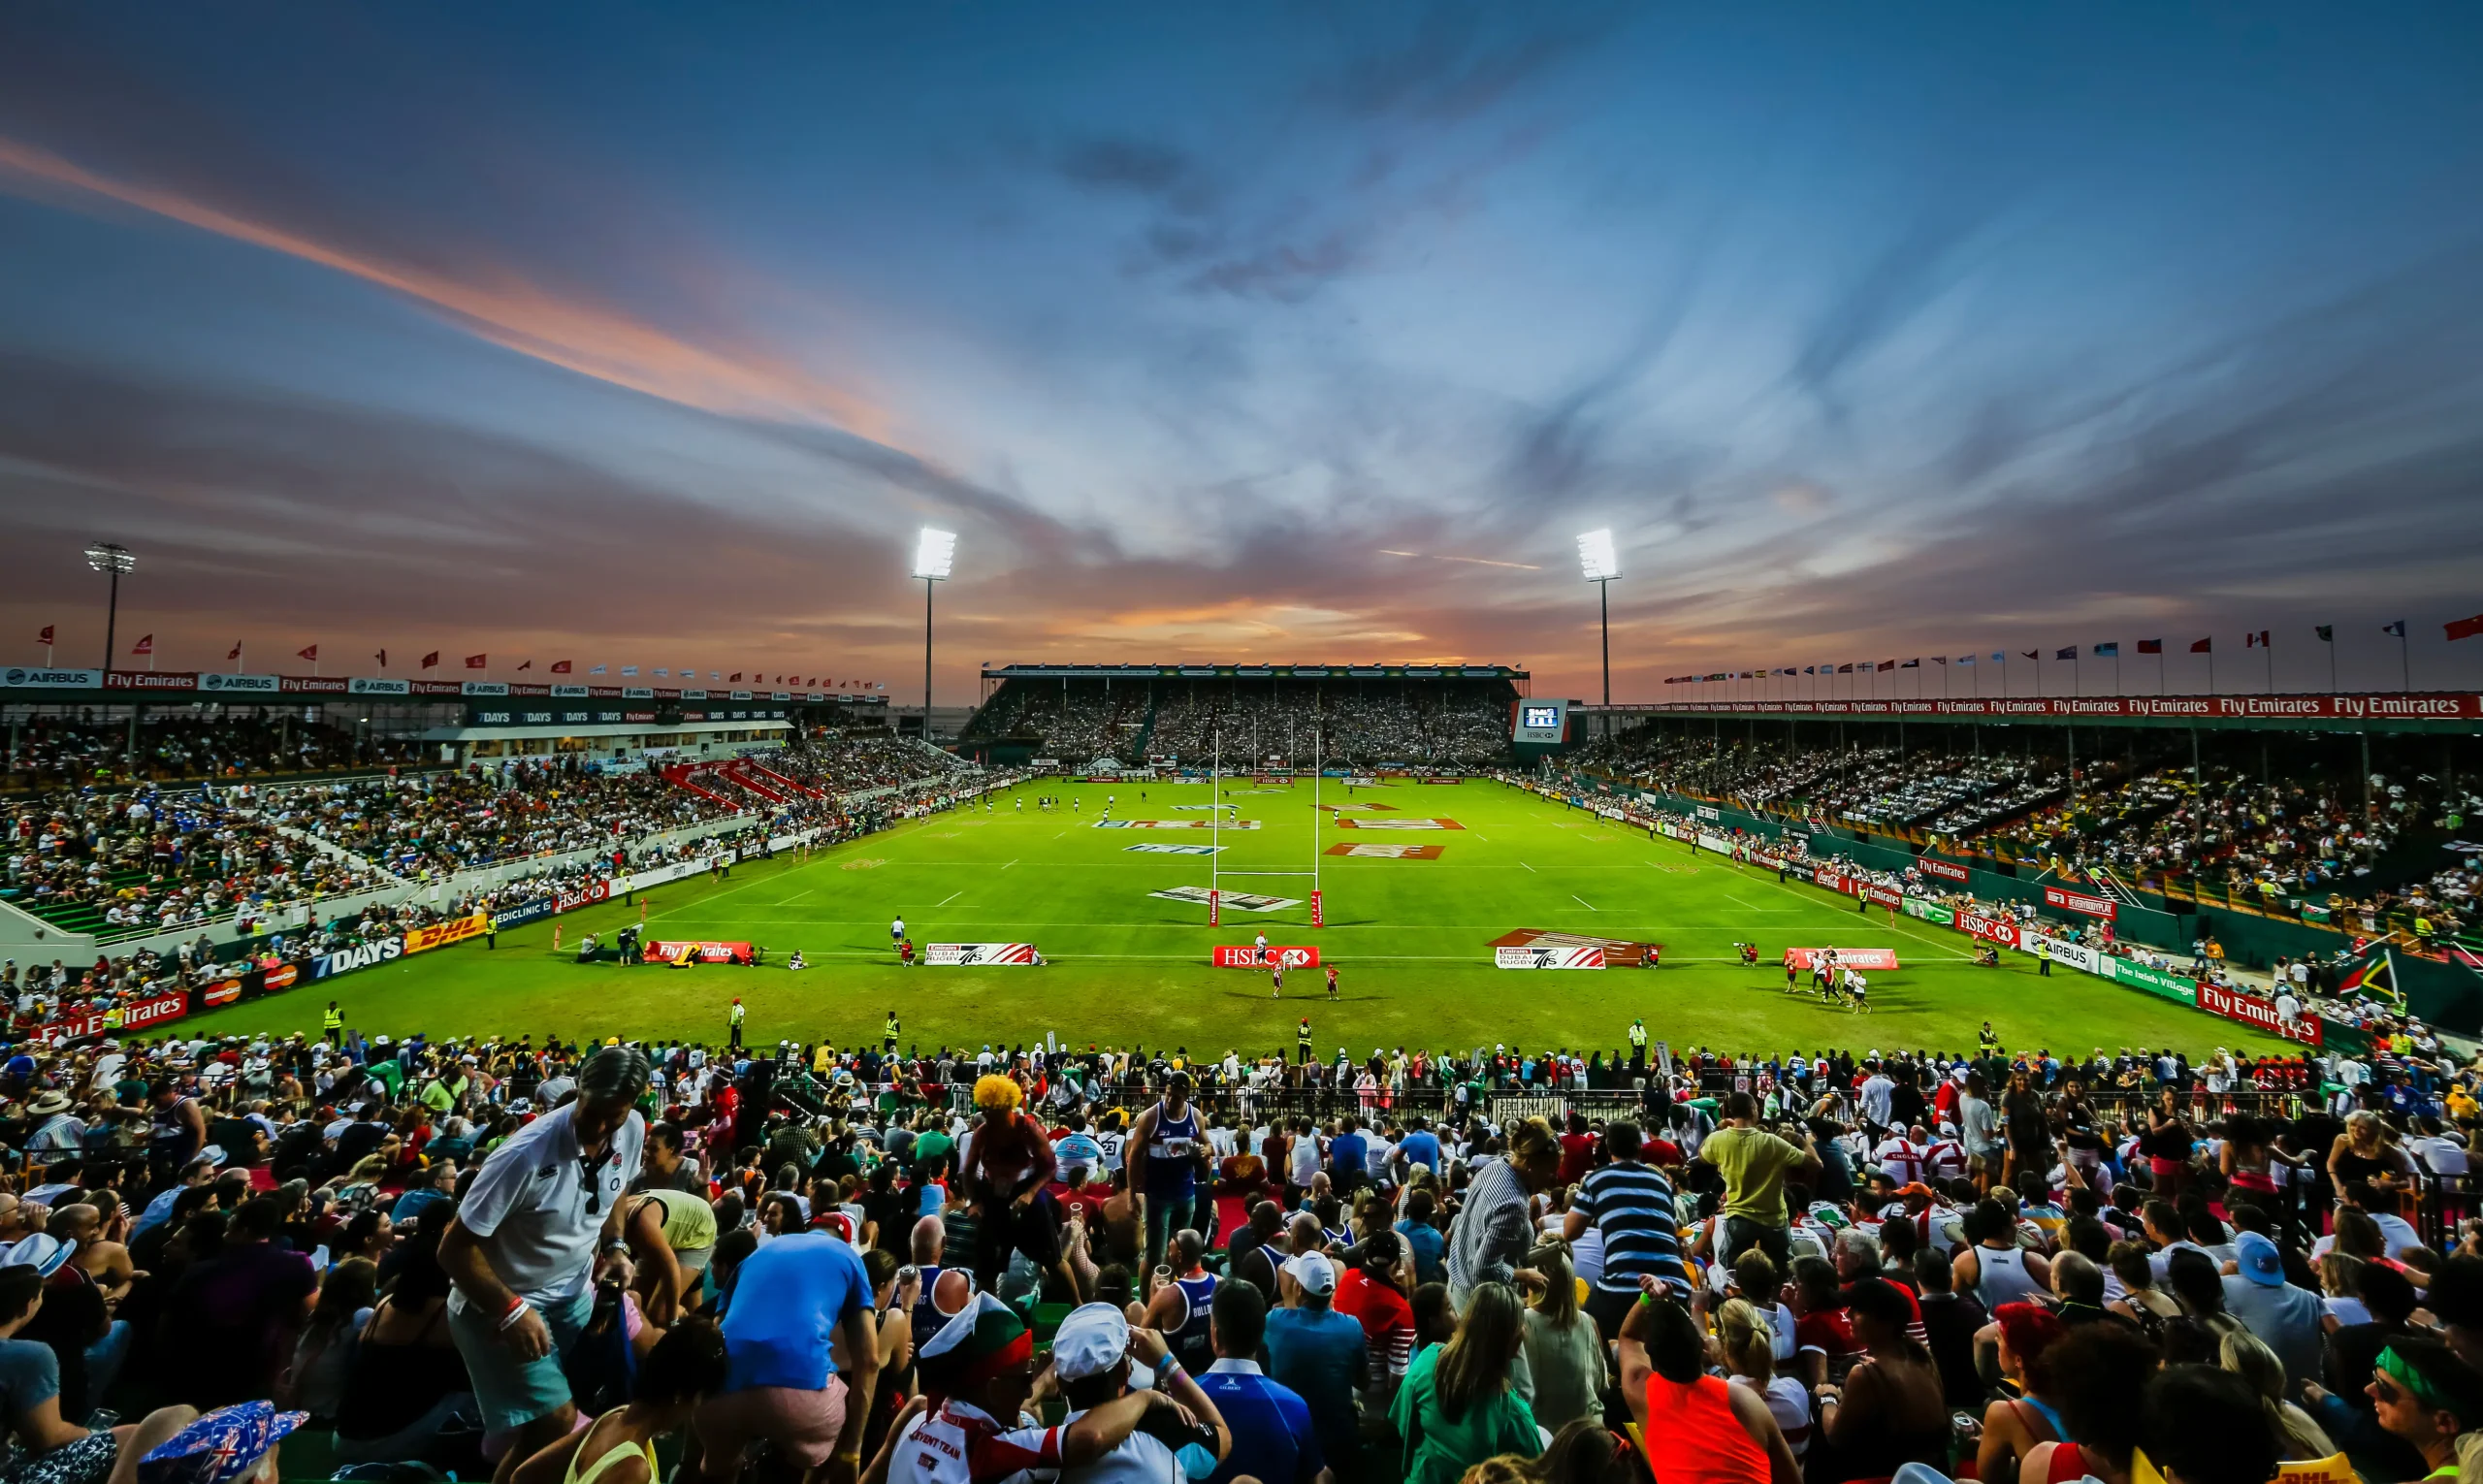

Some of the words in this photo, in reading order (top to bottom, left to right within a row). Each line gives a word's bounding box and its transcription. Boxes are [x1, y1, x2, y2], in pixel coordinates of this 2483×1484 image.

[28, 672, 88, 685] AIRBUS
[108, 674, 132, 688] Fly
[136, 674, 194, 686] Emirates
[224, 678, 272, 689] AIRBUS
[282, 679, 300, 692] Fly
[303, 680, 345, 691] Emirates
[368, 682, 403, 692] AIRBUS
[411, 683, 424, 694] Fly
[427, 683, 460, 693] Emirates
[476, 684, 504, 694] AIRBUS
[510, 684, 522, 694] Fly
[524, 685, 549, 694] Emirates
[590, 688, 600, 696] Fly
[600, 688, 621, 696] Emirates
[1816, 702, 1824, 713] Fly
[1851, 702, 1860, 713] Fly
[1862, 702, 1886, 711] Emirates
[1891, 701, 1902, 713] Fly
[1903, 701, 1932, 711] Emirates
[1937, 701, 1950, 714] Fly
[1951, 701, 1985, 712] Emirates
[1990, 700, 2005, 714] Fly
[2007, 700, 2046, 712] Emirates
[2053, 699, 2070, 715] Fly
[2072, 699, 2120, 712] Emirates
[2129, 699, 2149, 715] Fly
[2151, 698, 2209, 712] Emirates
[2220, 698, 2245, 716] Fly
[2248, 697, 2319, 713] Emirates
[2334, 697, 2365, 716] Fly
[2369, 696, 2460, 714] Emirates
[478, 712, 510, 723] 7DAYS
[522, 712, 551, 723] 7DAYS
[563, 712, 588, 722] 7DAYS
[597, 712, 621, 721] 7DAYS
[1919, 859, 1931, 873] Fly
[1933, 862, 1966, 880] Emirates
[1870, 887, 1900, 905] Emirates
[1960, 913, 1994, 937] HSBC
[420, 918, 477, 947] DHL
[312, 936, 401, 978] 7DAYS
[660, 945, 680, 958] Fly
[683, 943, 732, 957] irates
[2045, 942, 2086, 963] AIRBUS
[1837, 952, 1883, 964] mirates
[265, 970, 297, 984] MasterCard
[2116, 963, 2133, 976] The
[2135, 970, 2158, 984] Irish
[2160, 977, 2195, 996] Village
[205, 984, 242, 1000] MasterCard
[2203, 986, 2230, 1014] Fly
[2234, 996, 2315, 1037] Emires
[42, 1023, 81, 1042] Fy
[87, 996, 180, 1036] Eirates
[1103, 1144, 1114, 1153] 23
[914, 1430, 940, 1448] EVENT
[939, 1440, 961, 1461] TEAM
